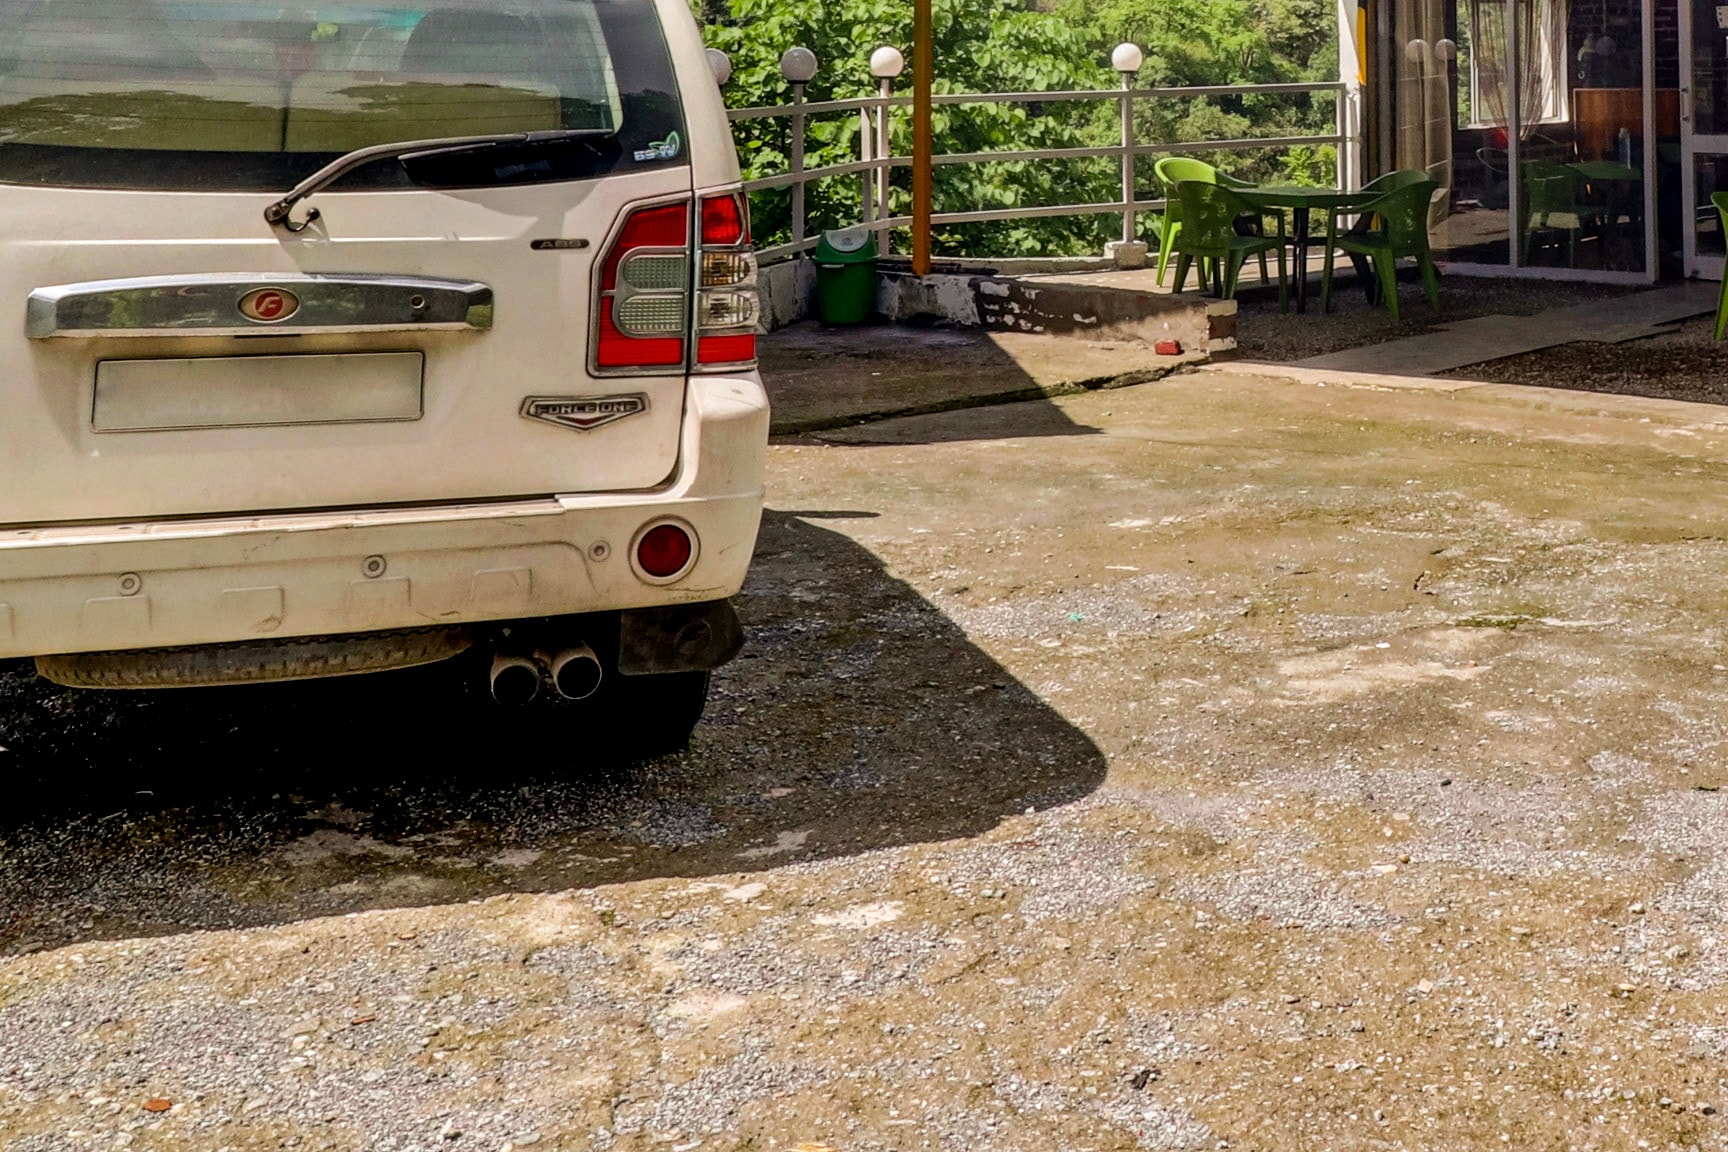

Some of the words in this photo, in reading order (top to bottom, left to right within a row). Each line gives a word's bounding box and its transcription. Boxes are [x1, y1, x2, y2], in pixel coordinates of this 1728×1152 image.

[539, 239, 583, 249] ABS
[537, 403, 597, 415] FORCE
[600, 401, 639, 414] ONE
